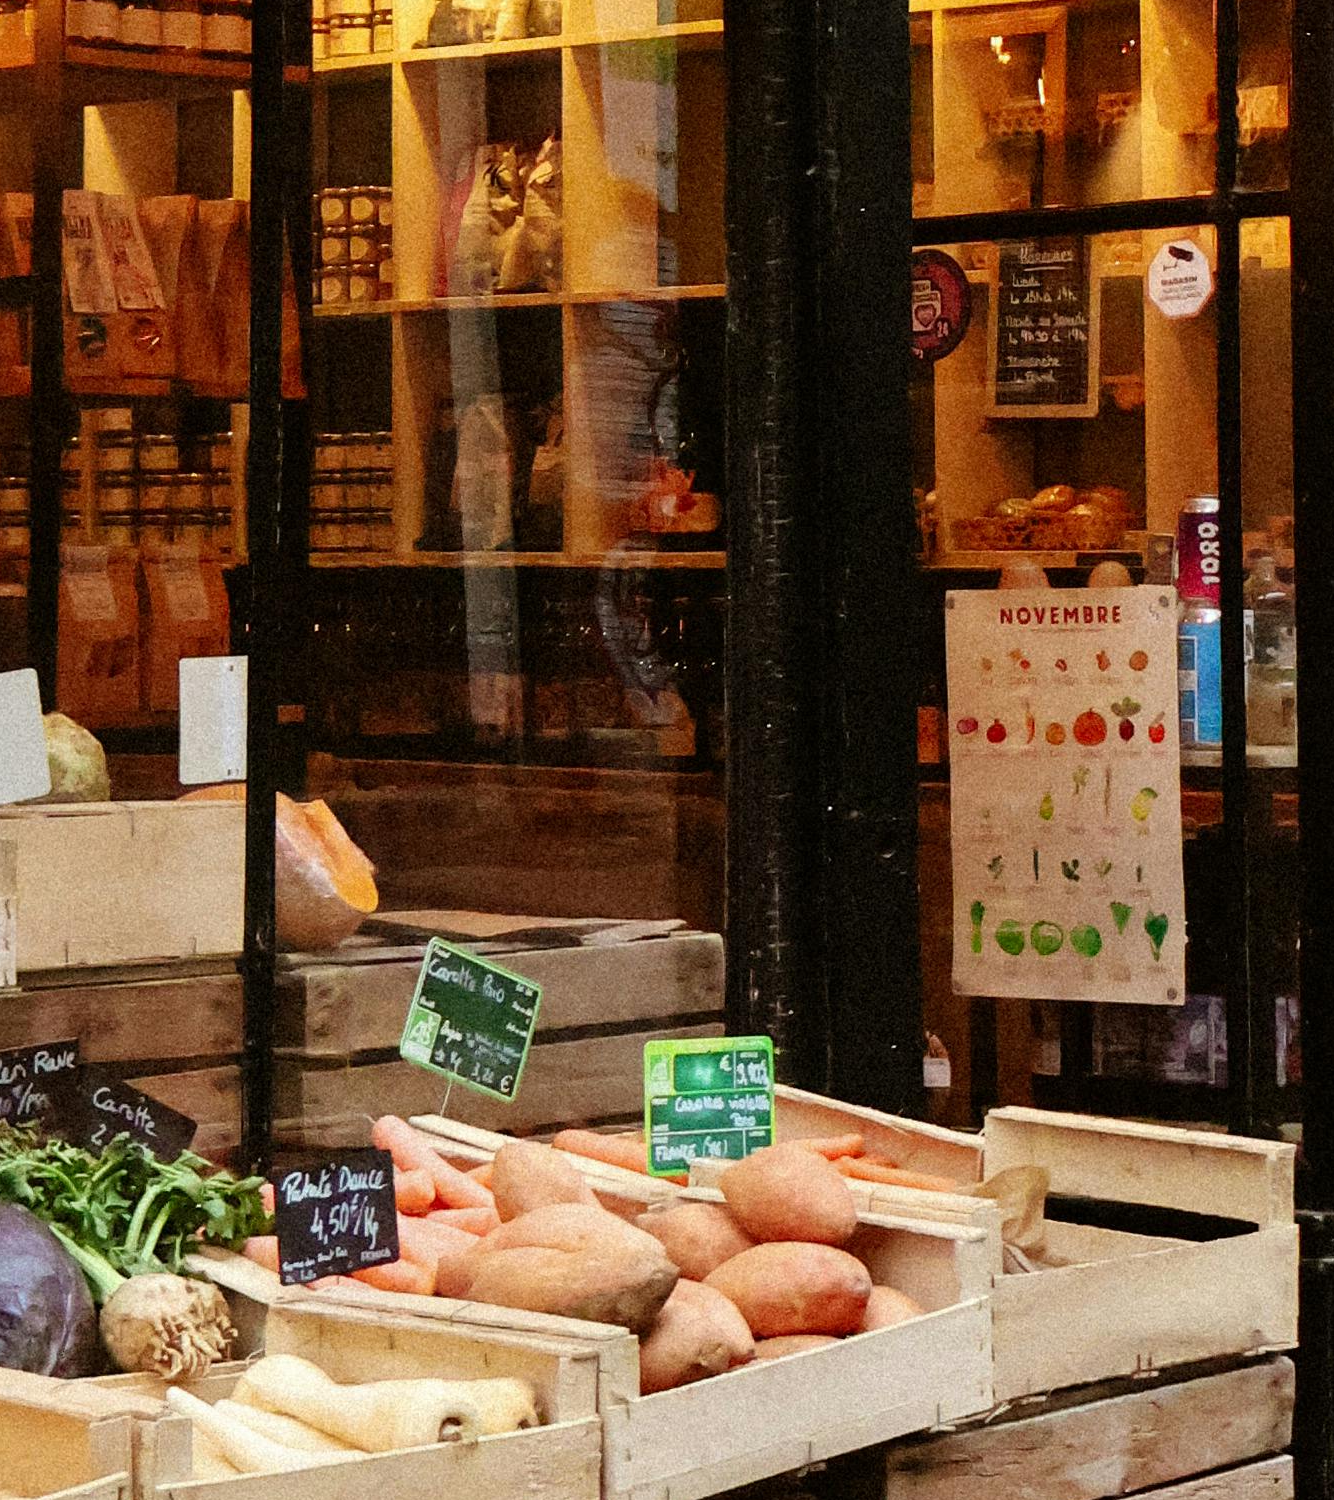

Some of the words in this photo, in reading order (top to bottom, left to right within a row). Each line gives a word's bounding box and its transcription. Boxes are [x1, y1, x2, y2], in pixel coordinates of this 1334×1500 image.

[999, 604, 1123, 626] NOVEMBRE
[33, 1050, 77, 1075] Rave
[92, 1086, 158, 1138] Carotte
[337, 1164, 390, 1193] Douce
